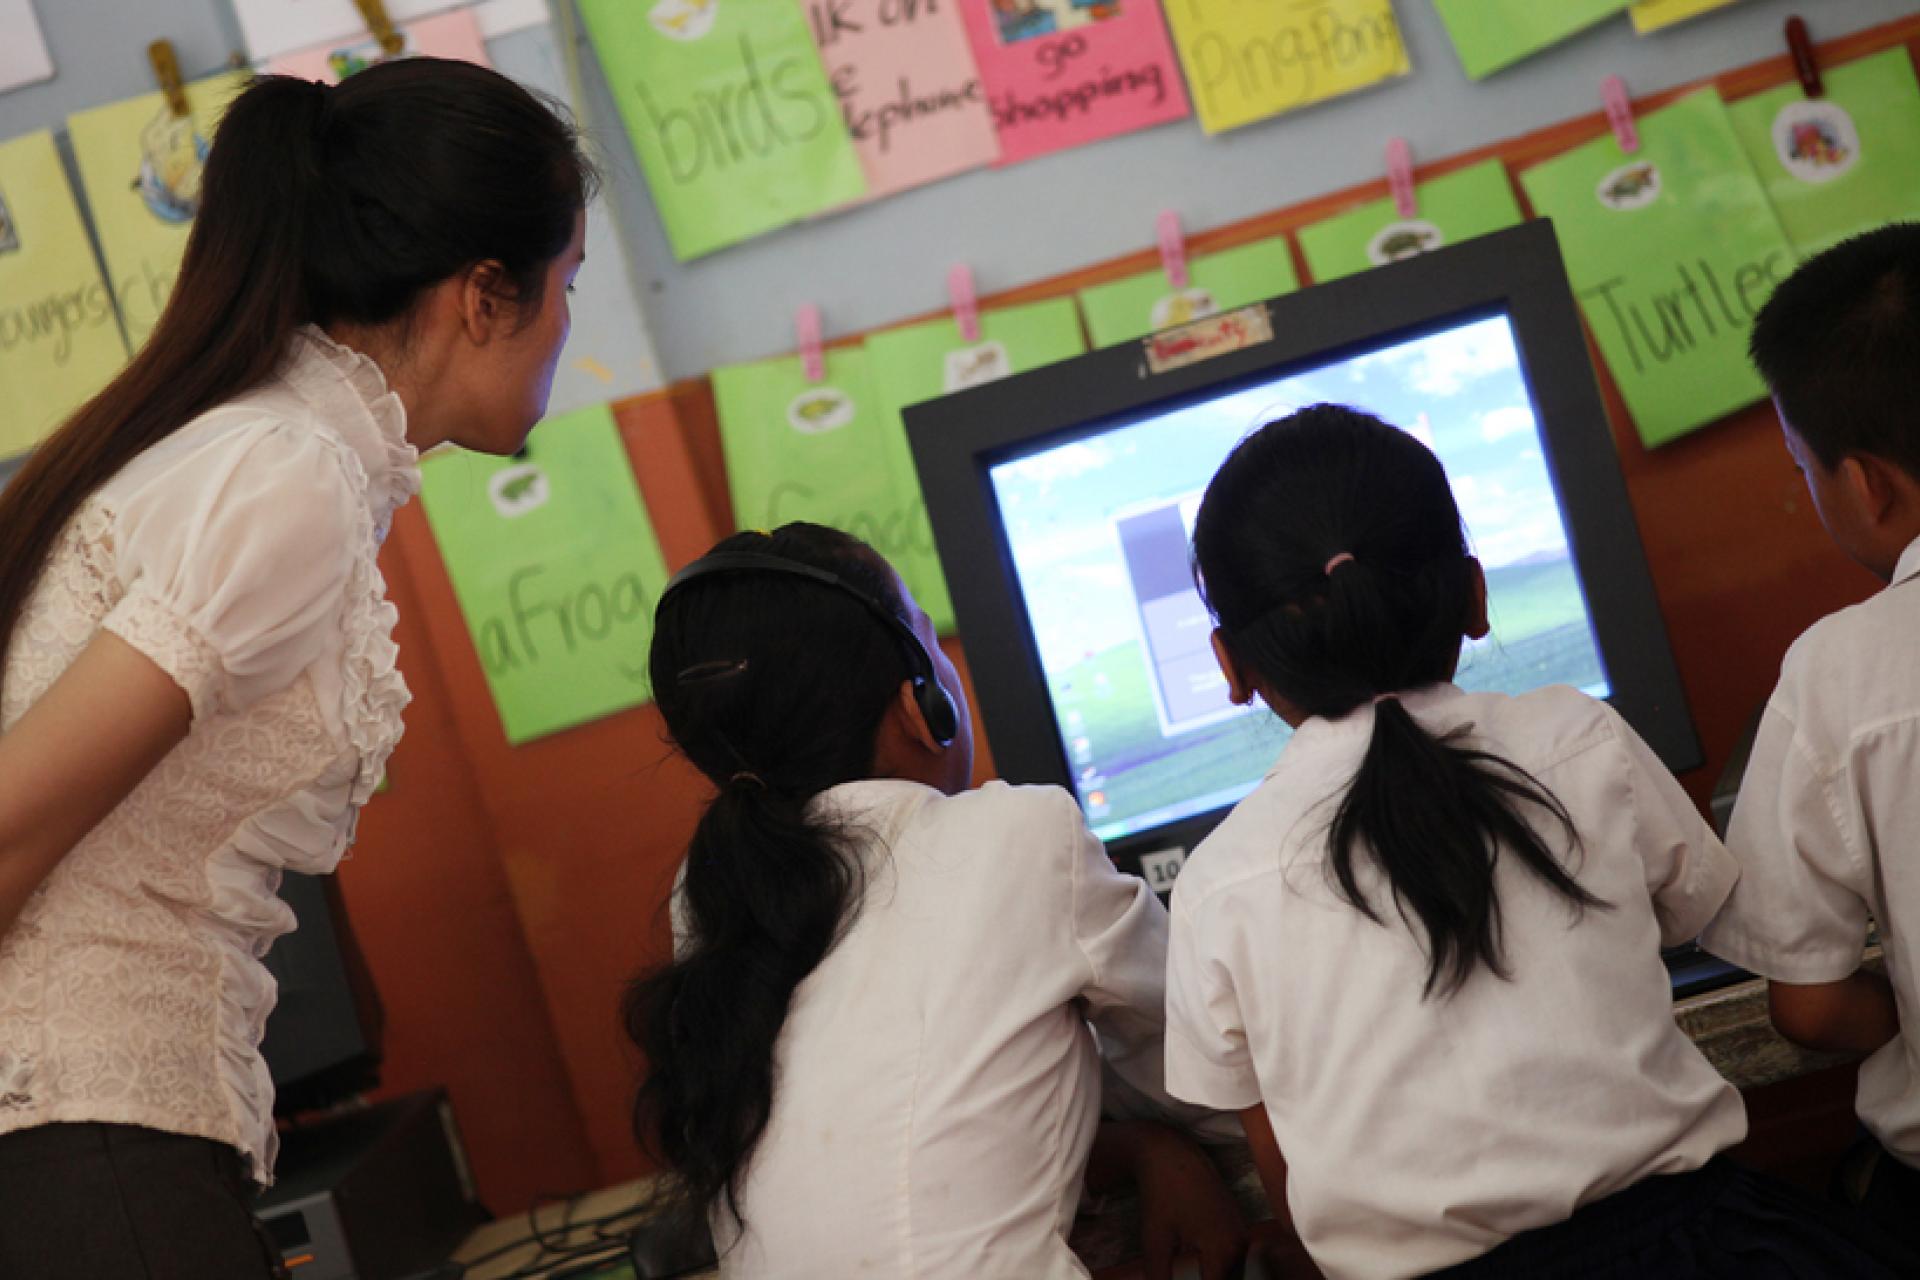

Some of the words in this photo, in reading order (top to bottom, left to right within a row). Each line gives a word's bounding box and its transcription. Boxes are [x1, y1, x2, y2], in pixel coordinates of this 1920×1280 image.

[1035, 33, 1088, 82] go
[634, 32, 827, 186] birds
[1152, 860, 1181, 882] 10
